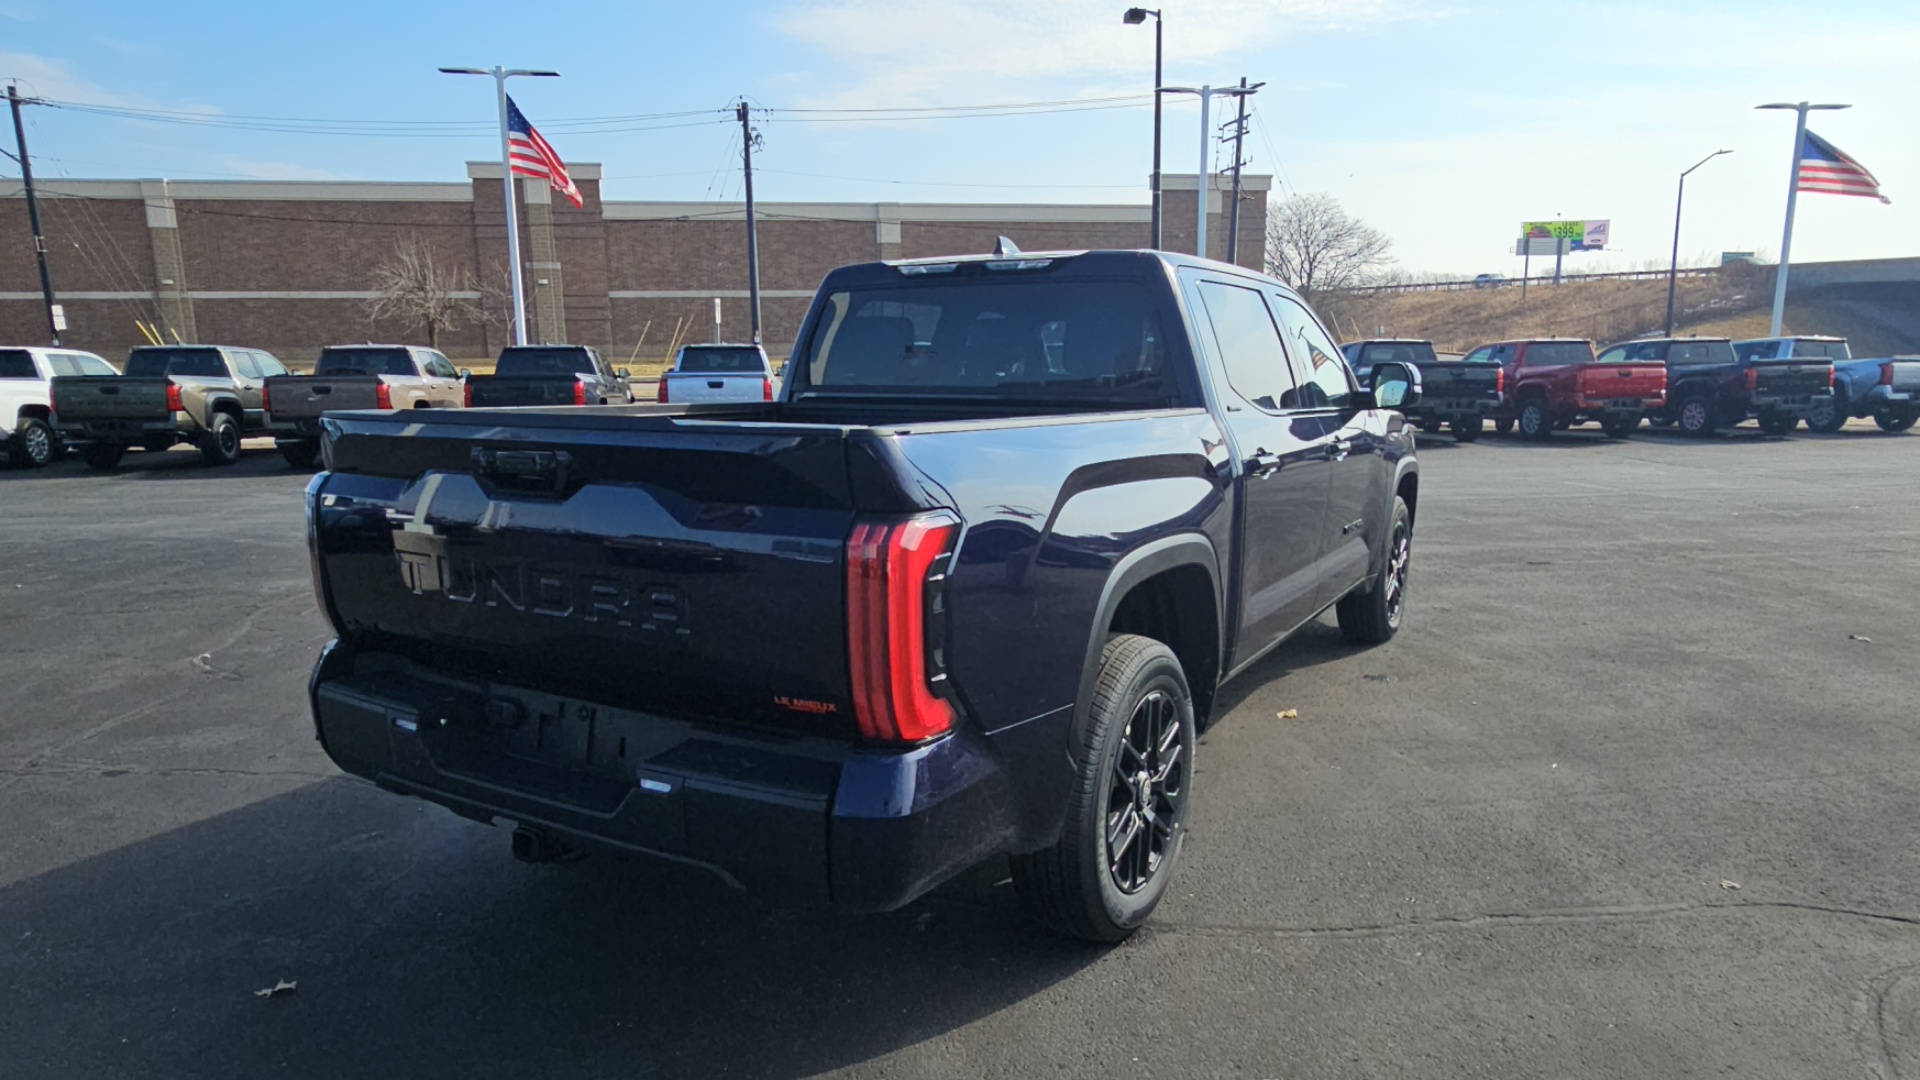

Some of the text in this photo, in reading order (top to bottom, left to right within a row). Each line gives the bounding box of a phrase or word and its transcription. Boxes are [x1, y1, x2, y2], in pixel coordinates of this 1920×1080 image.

[394, 548, 690, 635] TUNDRA
[773, 695, 790, 706] LE
[793, 698, 838, 712] MIEUX
